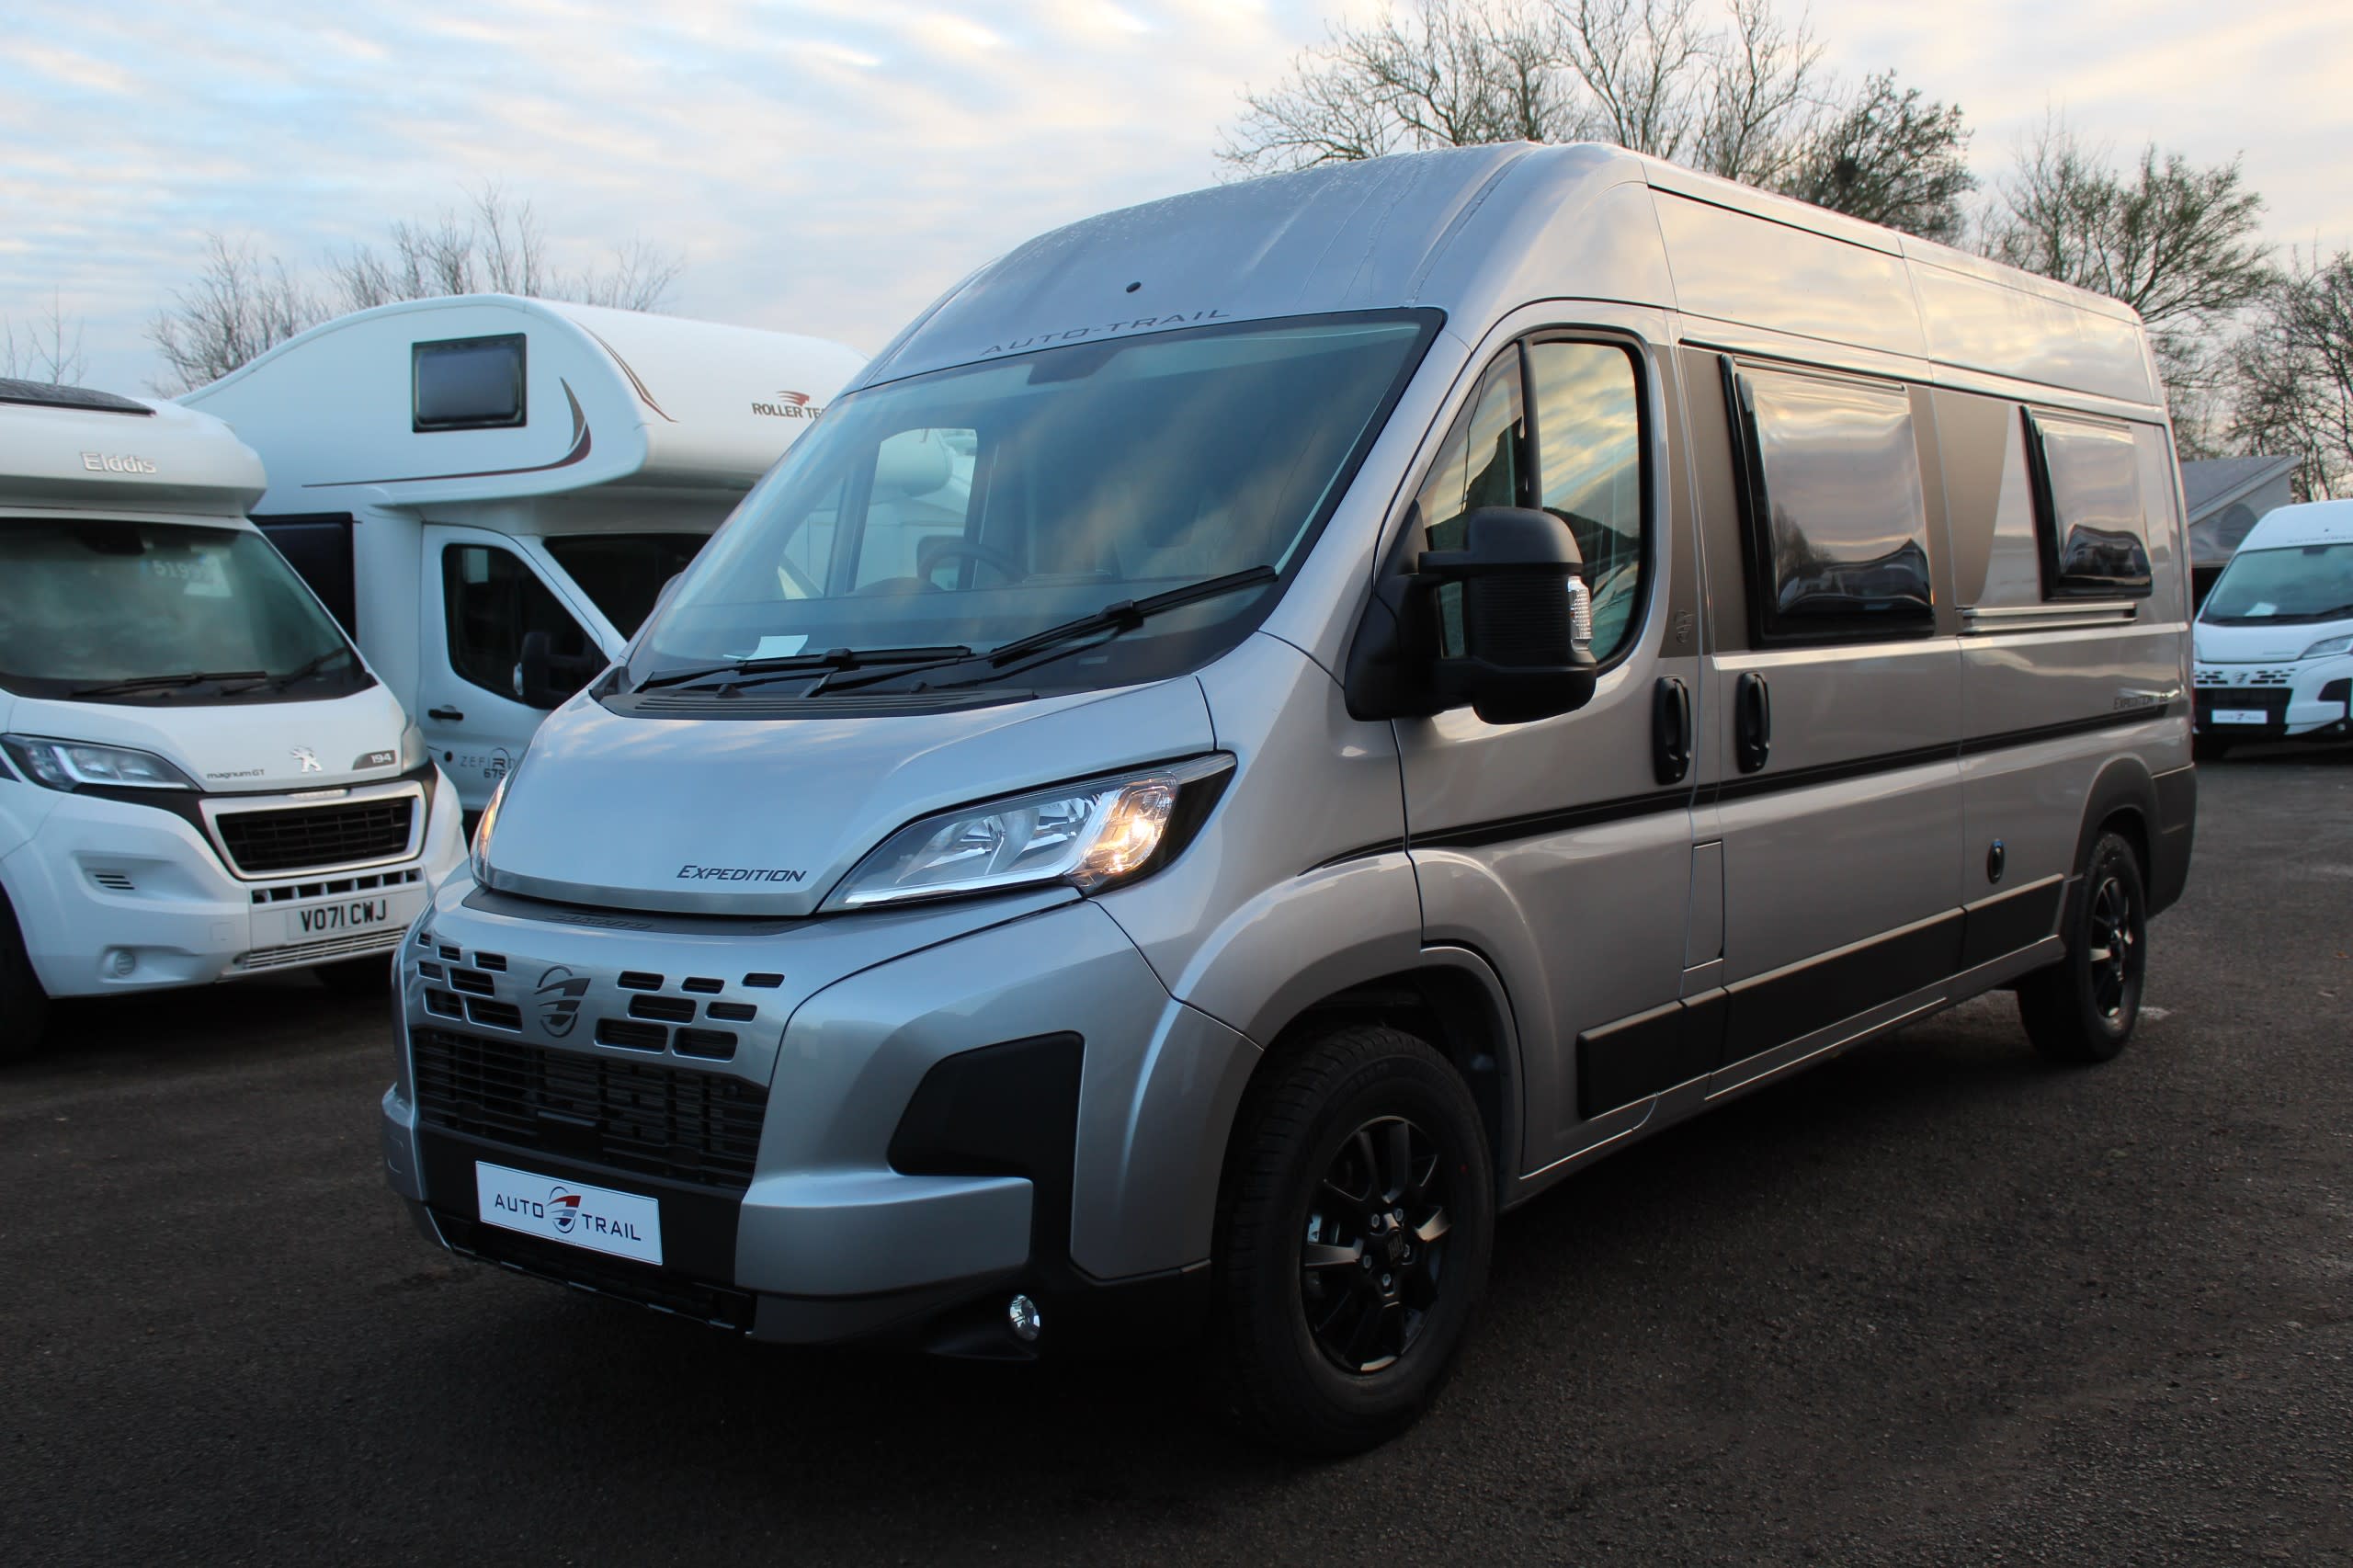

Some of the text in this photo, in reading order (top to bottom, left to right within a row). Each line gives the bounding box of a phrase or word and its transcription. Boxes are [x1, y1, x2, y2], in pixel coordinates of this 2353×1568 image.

[979, 309, 1231, 356] AUTO-TRAIL
[751, 403, 803, 418] ROLLER
[80, 451, 156, 473] Elddis
[370, 753, 392, 764] 194
[301, 900, 386, 932] VO71 CWJ
[494, 1194, 642, 1242] AUTO TRAIL
